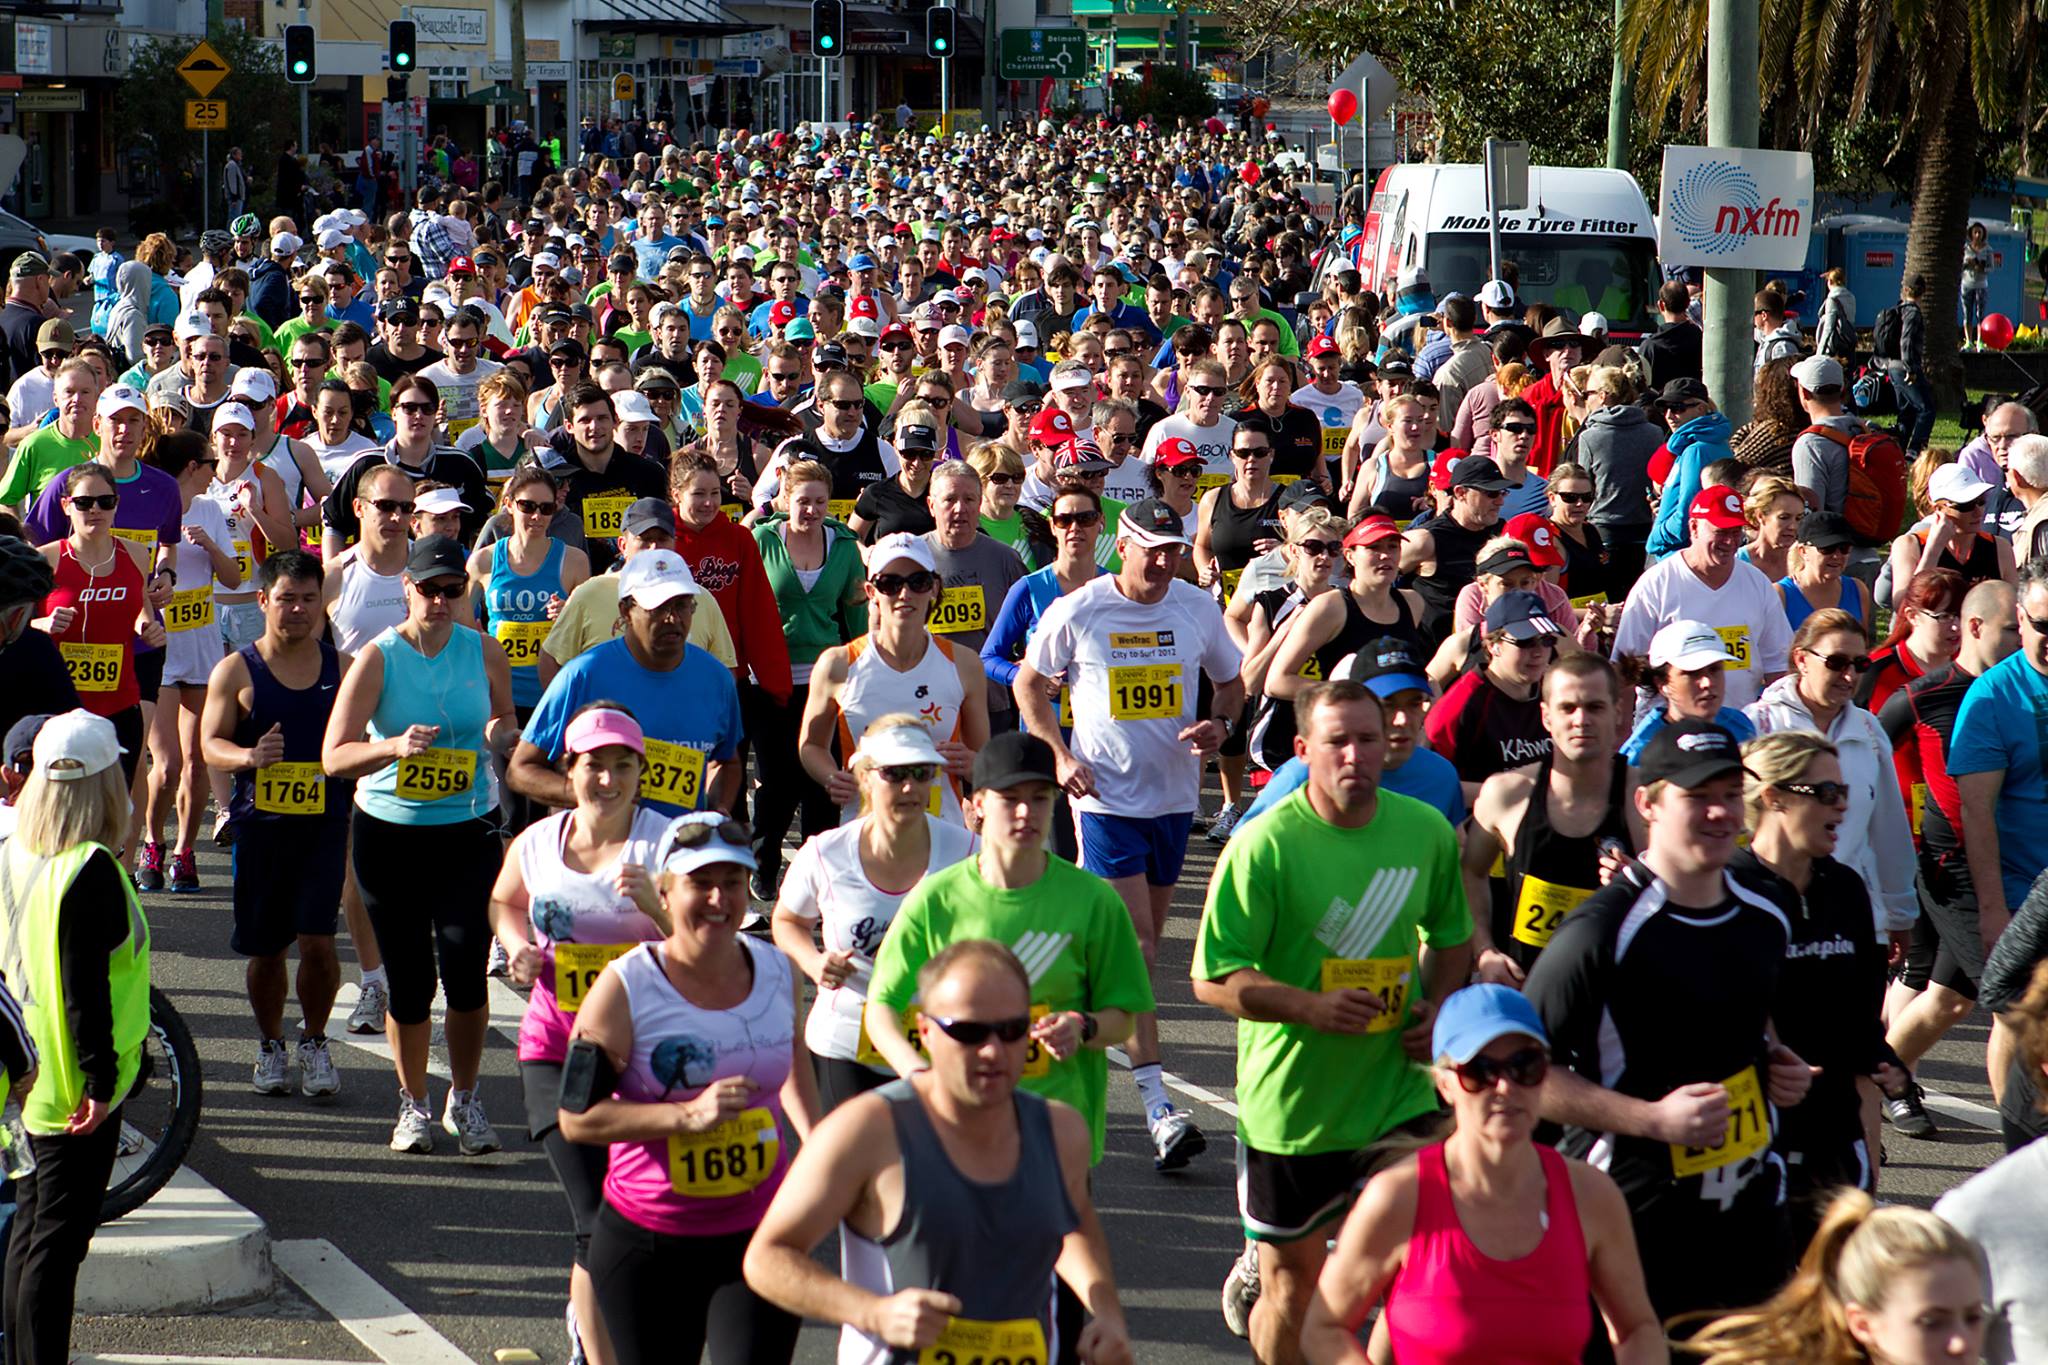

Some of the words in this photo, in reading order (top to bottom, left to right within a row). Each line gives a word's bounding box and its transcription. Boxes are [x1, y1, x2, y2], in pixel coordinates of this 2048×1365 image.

[458, 15, 483, 35] Travel
[195, 103, 218, 119] 25
[1441, 215, 1521, 230] Moble
[1527, 217, 1575, 233] Tyre
[1580, 218, 1639, 234] Fitter
[1714, 197, 1800, 237] nxfm
[1325, 436, 1346, 449] 169
[589, 511, 622, 530] 183
[169, 601, 210, 624] 1597
[932, 603, 982, 625] 2093
[502, 638, 541, 659] 254
[1111, 650, 1127, 660] City
[1158, 648, 1176, 657] 2012
[1726, 641, 1746, 661] 95
[66, 660, 118, 683] 2369
[1117, 683, 1176, 710] 1991
[403, 764, 468, 792] 2559
[262, 780, 320, 804] 1764
[1525, 904, 1565, 932] 24
[679, 1143, 767, 1183] 1681
